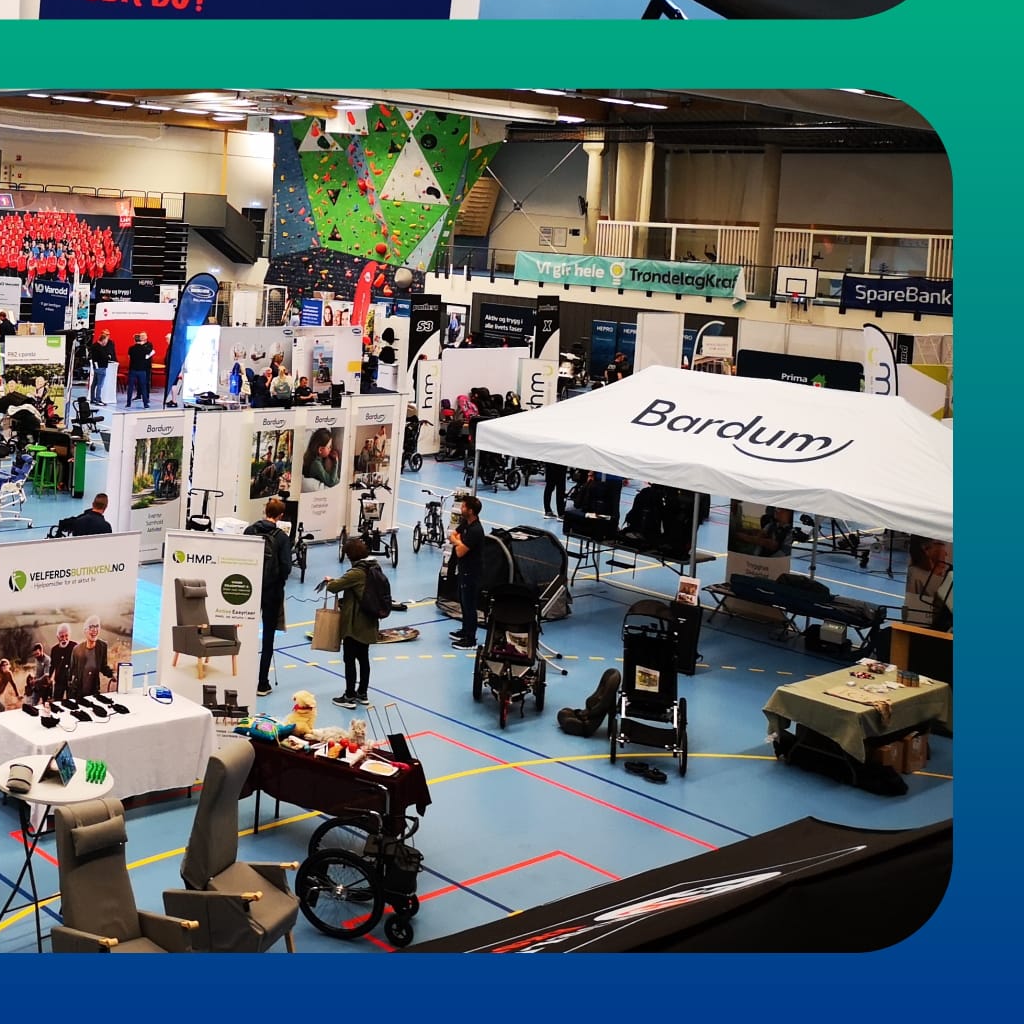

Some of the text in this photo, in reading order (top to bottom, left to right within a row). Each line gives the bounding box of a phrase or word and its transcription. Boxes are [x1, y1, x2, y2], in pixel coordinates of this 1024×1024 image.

[536, 260, 737, 290] Vi gir hele TrøndelagKraf
[44, 285, 68, 296] Varodd
[855, 284, 952, 305] SpareBank
[485, 314, 497, 322] Aktiv
[506, 317, 520, 326] trygg
[416, 321, 434, 332] S3
[781, 372, 808, 384] Prima
[262, 417, 286, 428] Bardum
[314, 415, 337, 426] Bardum
[365, 412, 386, 423] Bardum
[146, 424, 174, 436] Bardum
[630, 399, 854, 464] Bardum
[29, 562, 125, 582] VELFERDSBUTIKKEN.NO
